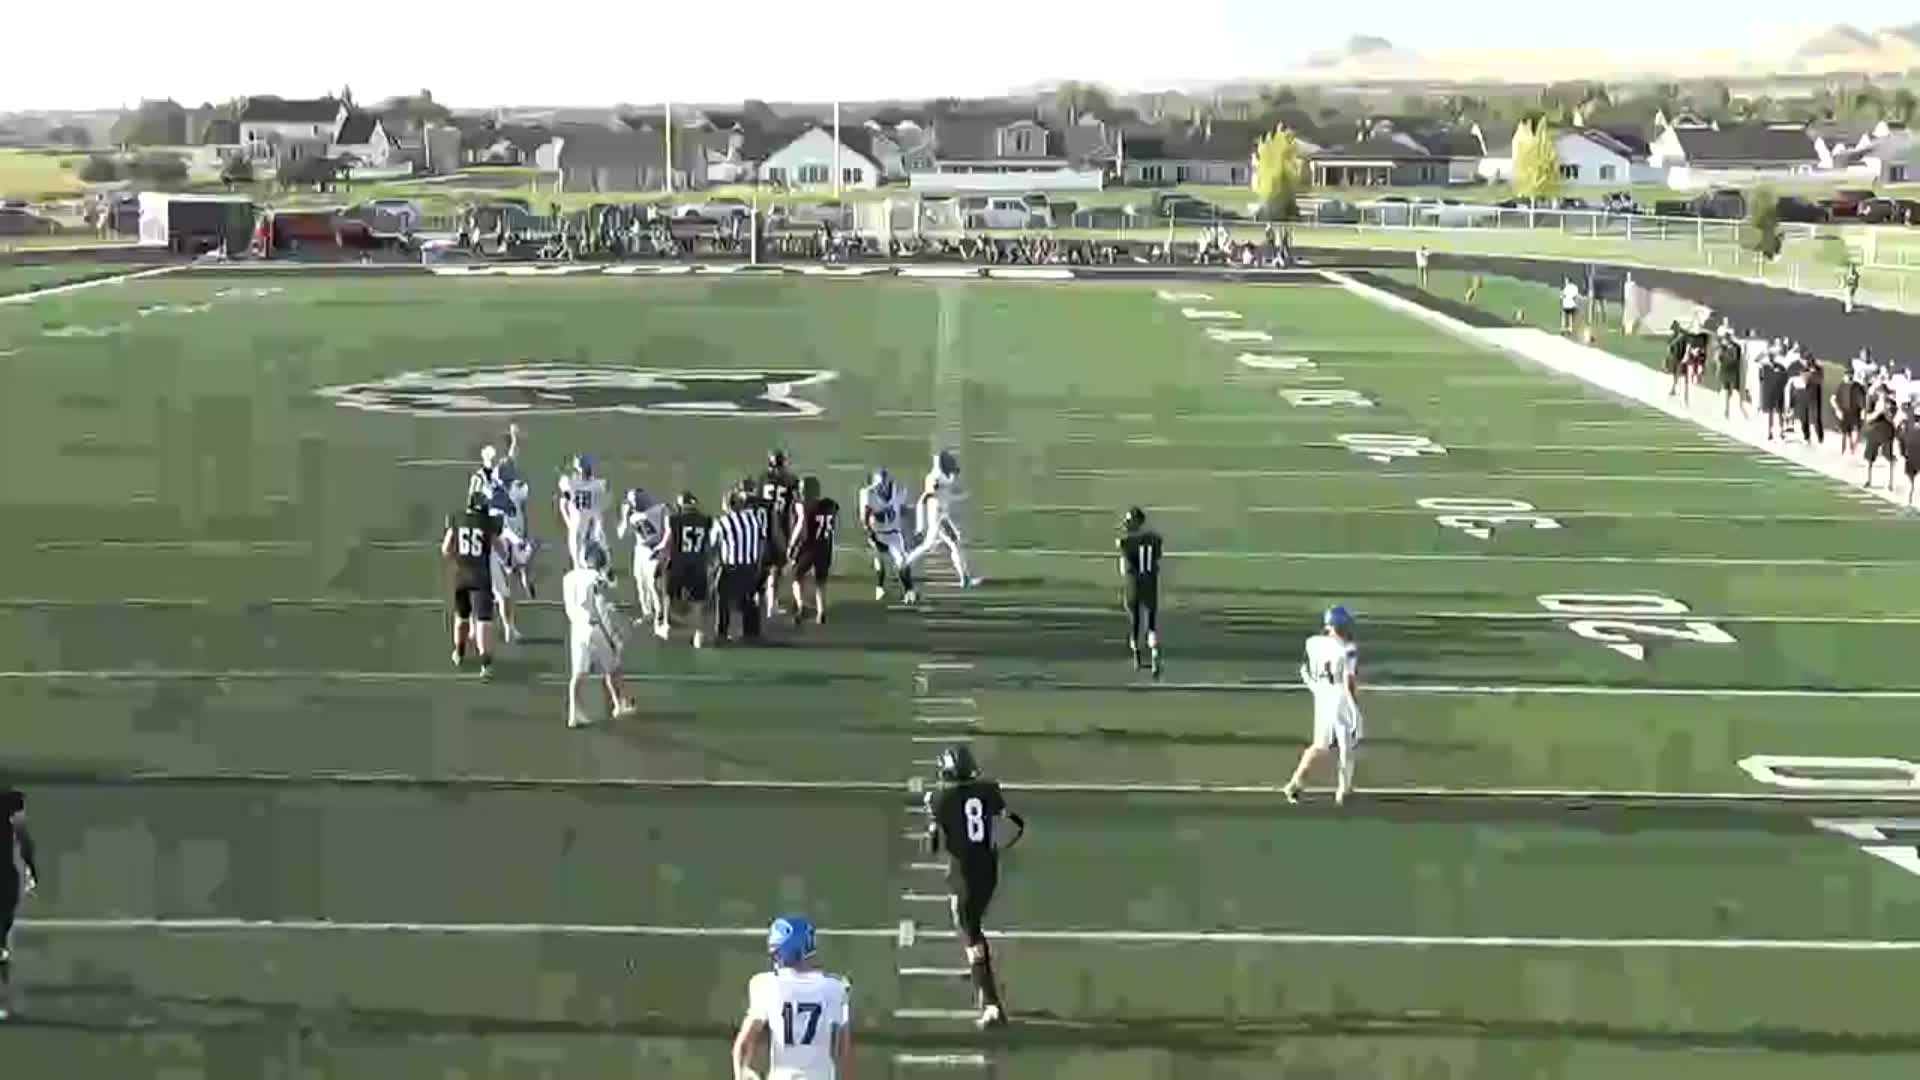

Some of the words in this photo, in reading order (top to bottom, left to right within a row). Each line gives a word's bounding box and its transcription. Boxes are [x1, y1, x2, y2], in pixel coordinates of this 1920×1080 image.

[458, 527, 484, 557] 66
[1139, 545, 1152, 573] 11
[1536, 594, 1738, 643] 20
[965, 798, 985, 842] 8
[781, 1001, 823, 1045] 17
